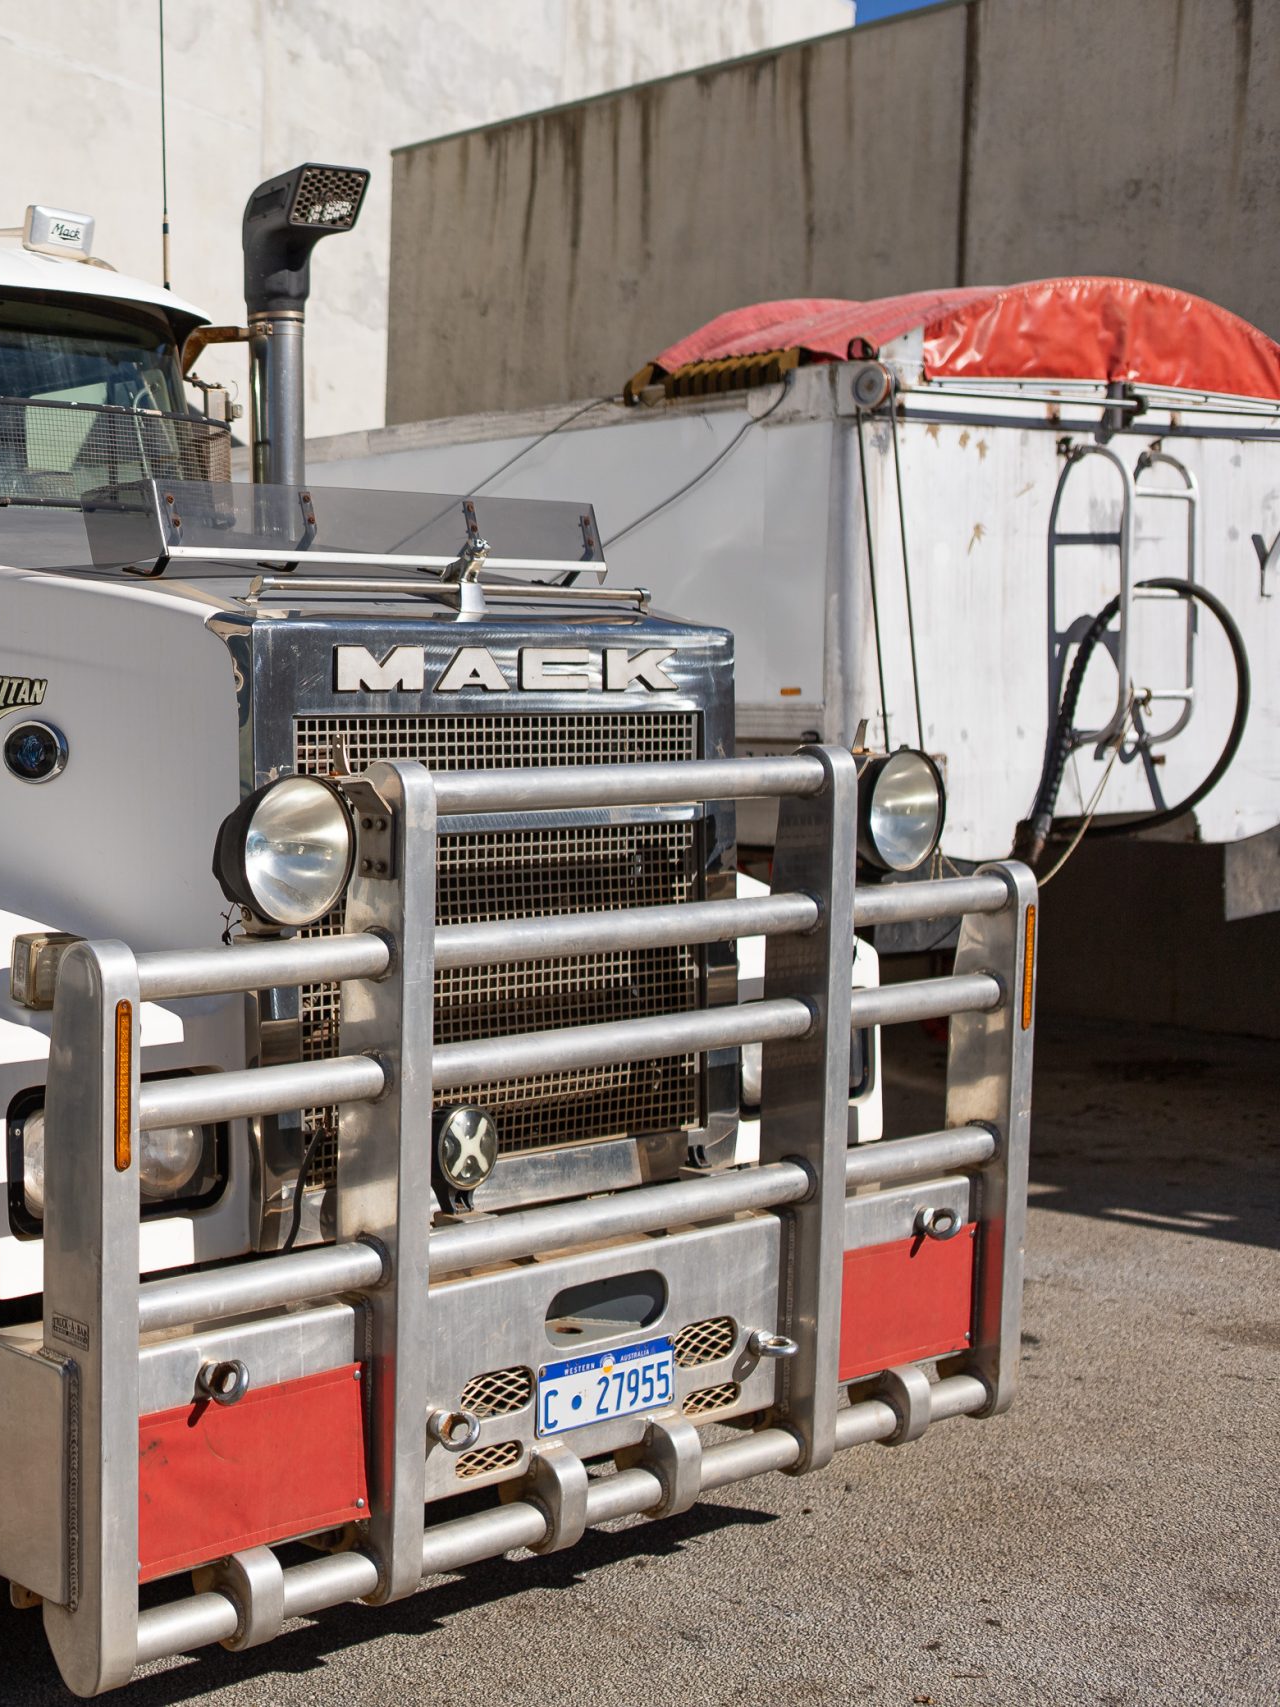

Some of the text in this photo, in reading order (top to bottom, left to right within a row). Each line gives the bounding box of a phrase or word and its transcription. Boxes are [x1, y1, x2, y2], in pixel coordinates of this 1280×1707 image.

[50, 223, 81, 241] Mack
[332, 645, 678, 693] MACK
[563, 1348, 650, 1376] WESTERN AUSTRALIA
[544, 1360, 670, 1430] C 27955
